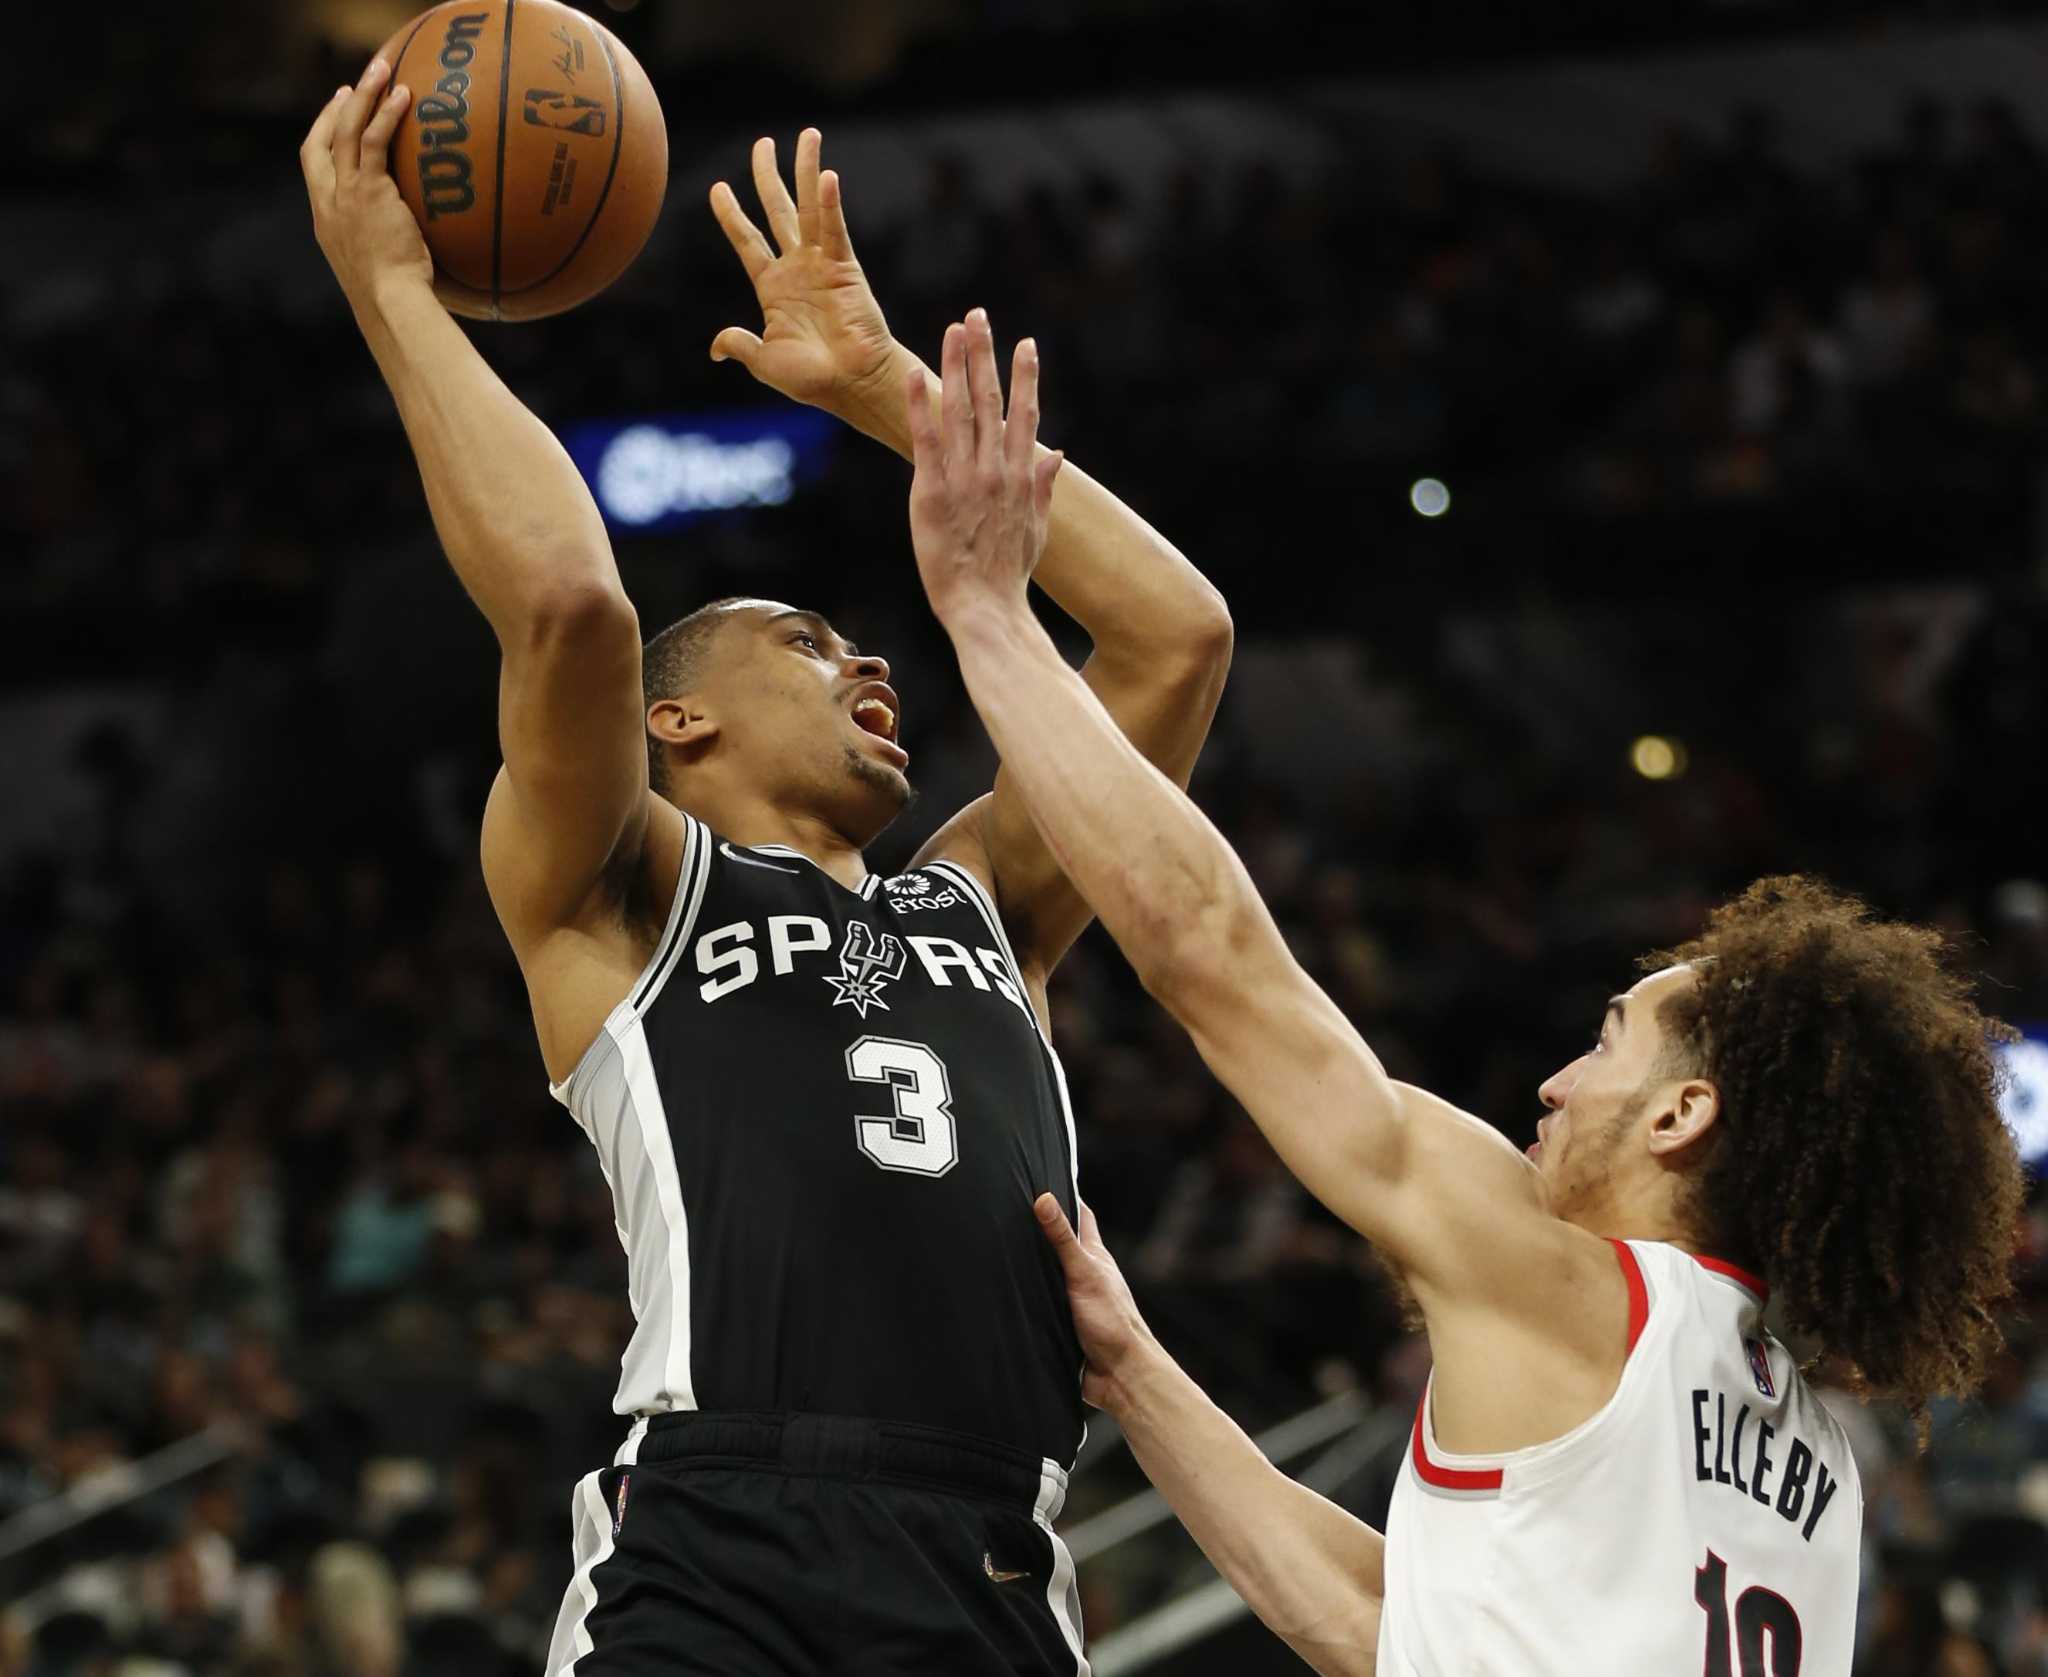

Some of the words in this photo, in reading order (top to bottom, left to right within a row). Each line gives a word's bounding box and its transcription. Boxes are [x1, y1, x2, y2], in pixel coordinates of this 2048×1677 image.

[415, 12, 490, 222] Wilson
[889, 885, 968, 914] Frost
[844, 1035, 959, 1178] 3
[1692, 1389, 1837, 1542] ELLEBY
